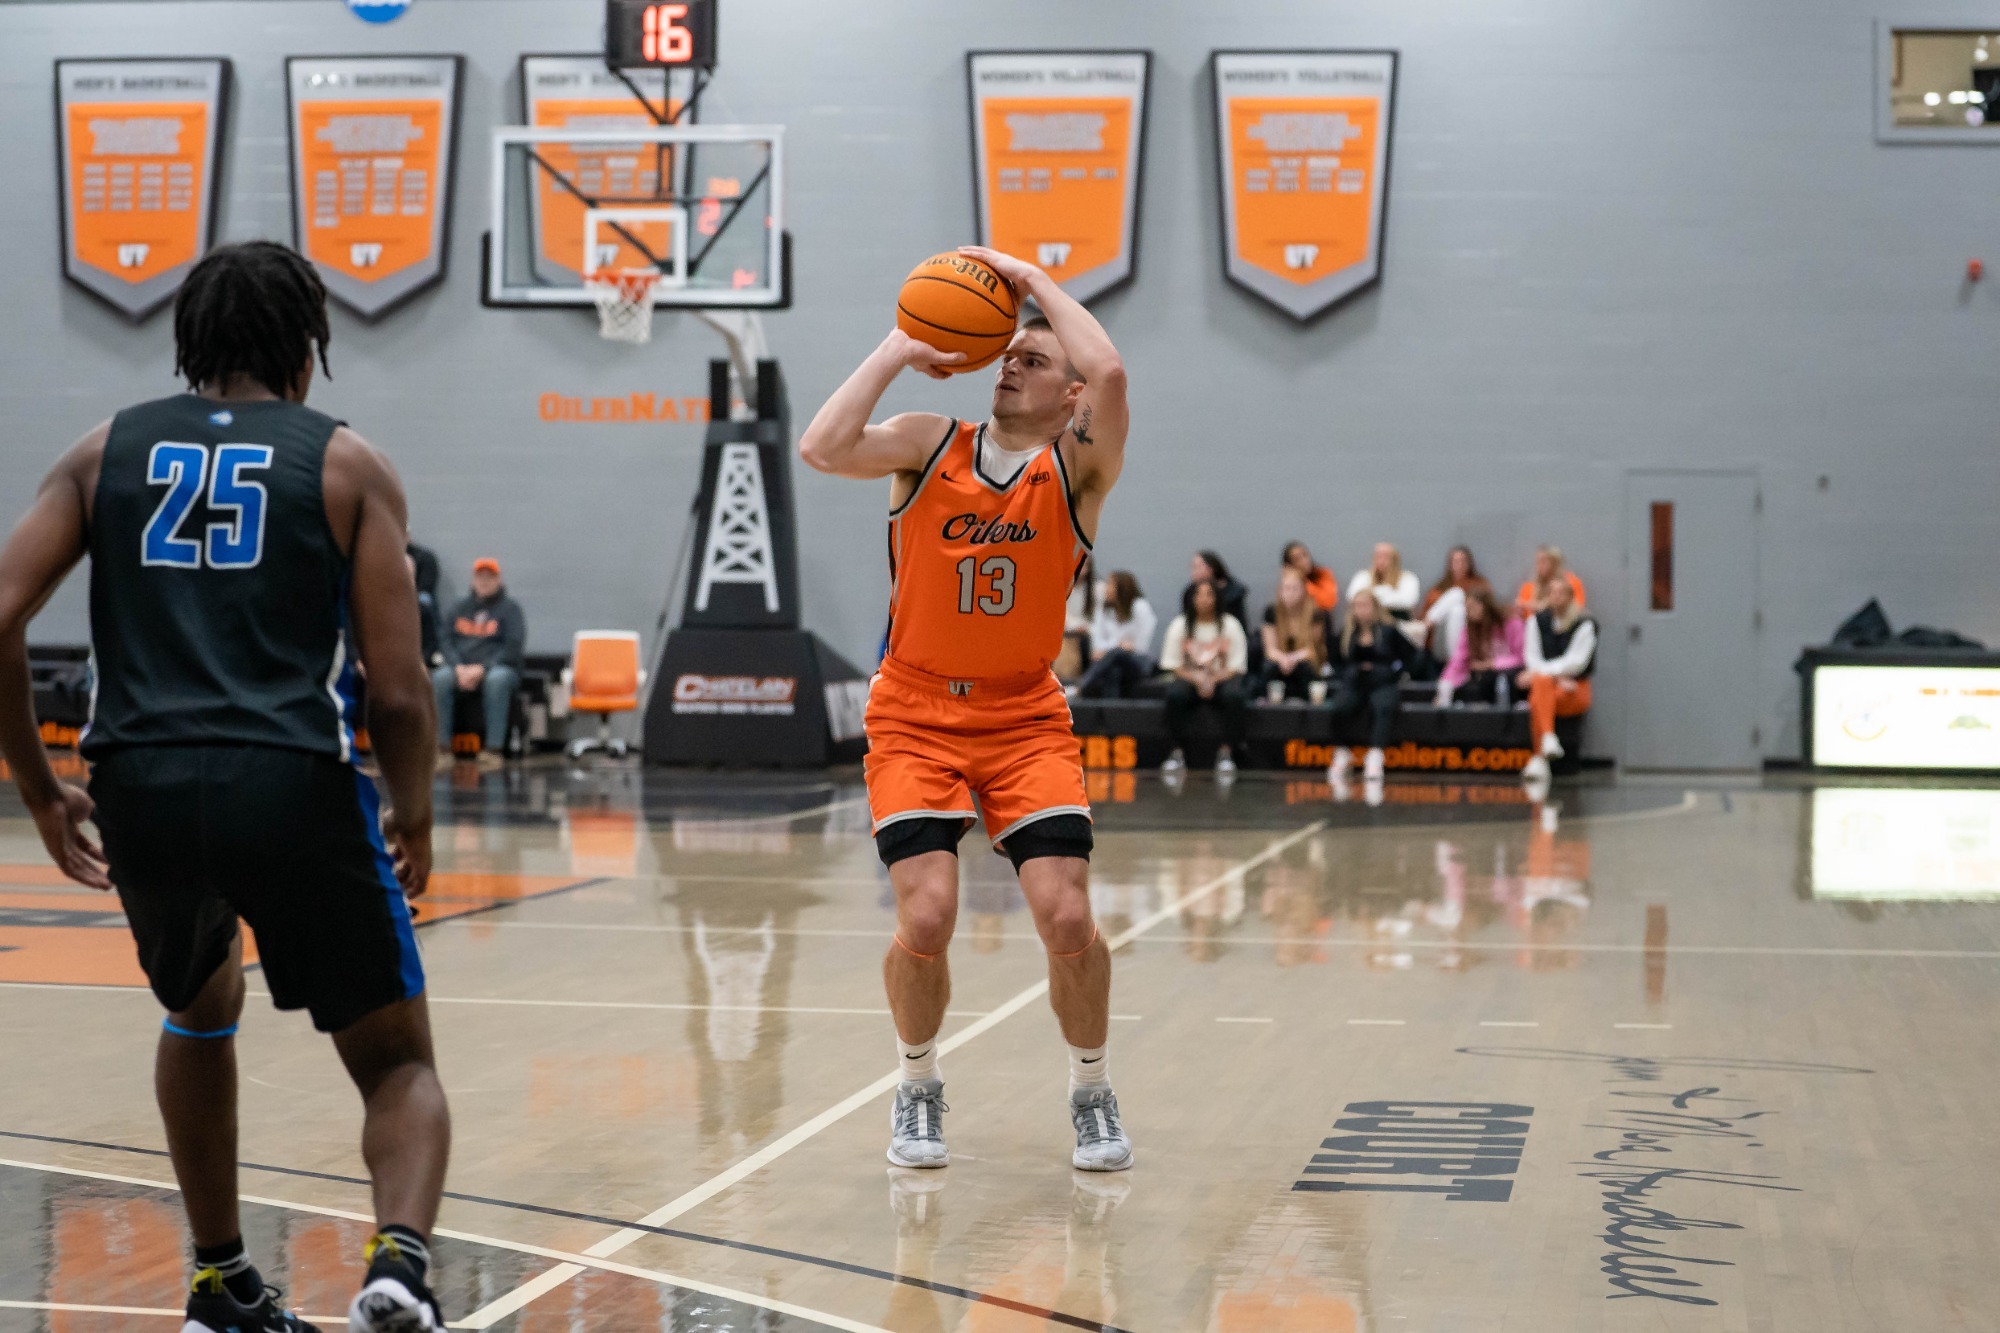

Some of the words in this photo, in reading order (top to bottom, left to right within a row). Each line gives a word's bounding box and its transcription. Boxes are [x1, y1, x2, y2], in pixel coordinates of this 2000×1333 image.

[642, 4, 692, 62] 16
[926, 256, 999, 295] Wilson
[141, 441, 273, 569] 25
[942, 513, 1037, 544] Oilers
[956, 556, 1016, 616] 13
[1291, 1100, 1535, 1202] COURT
